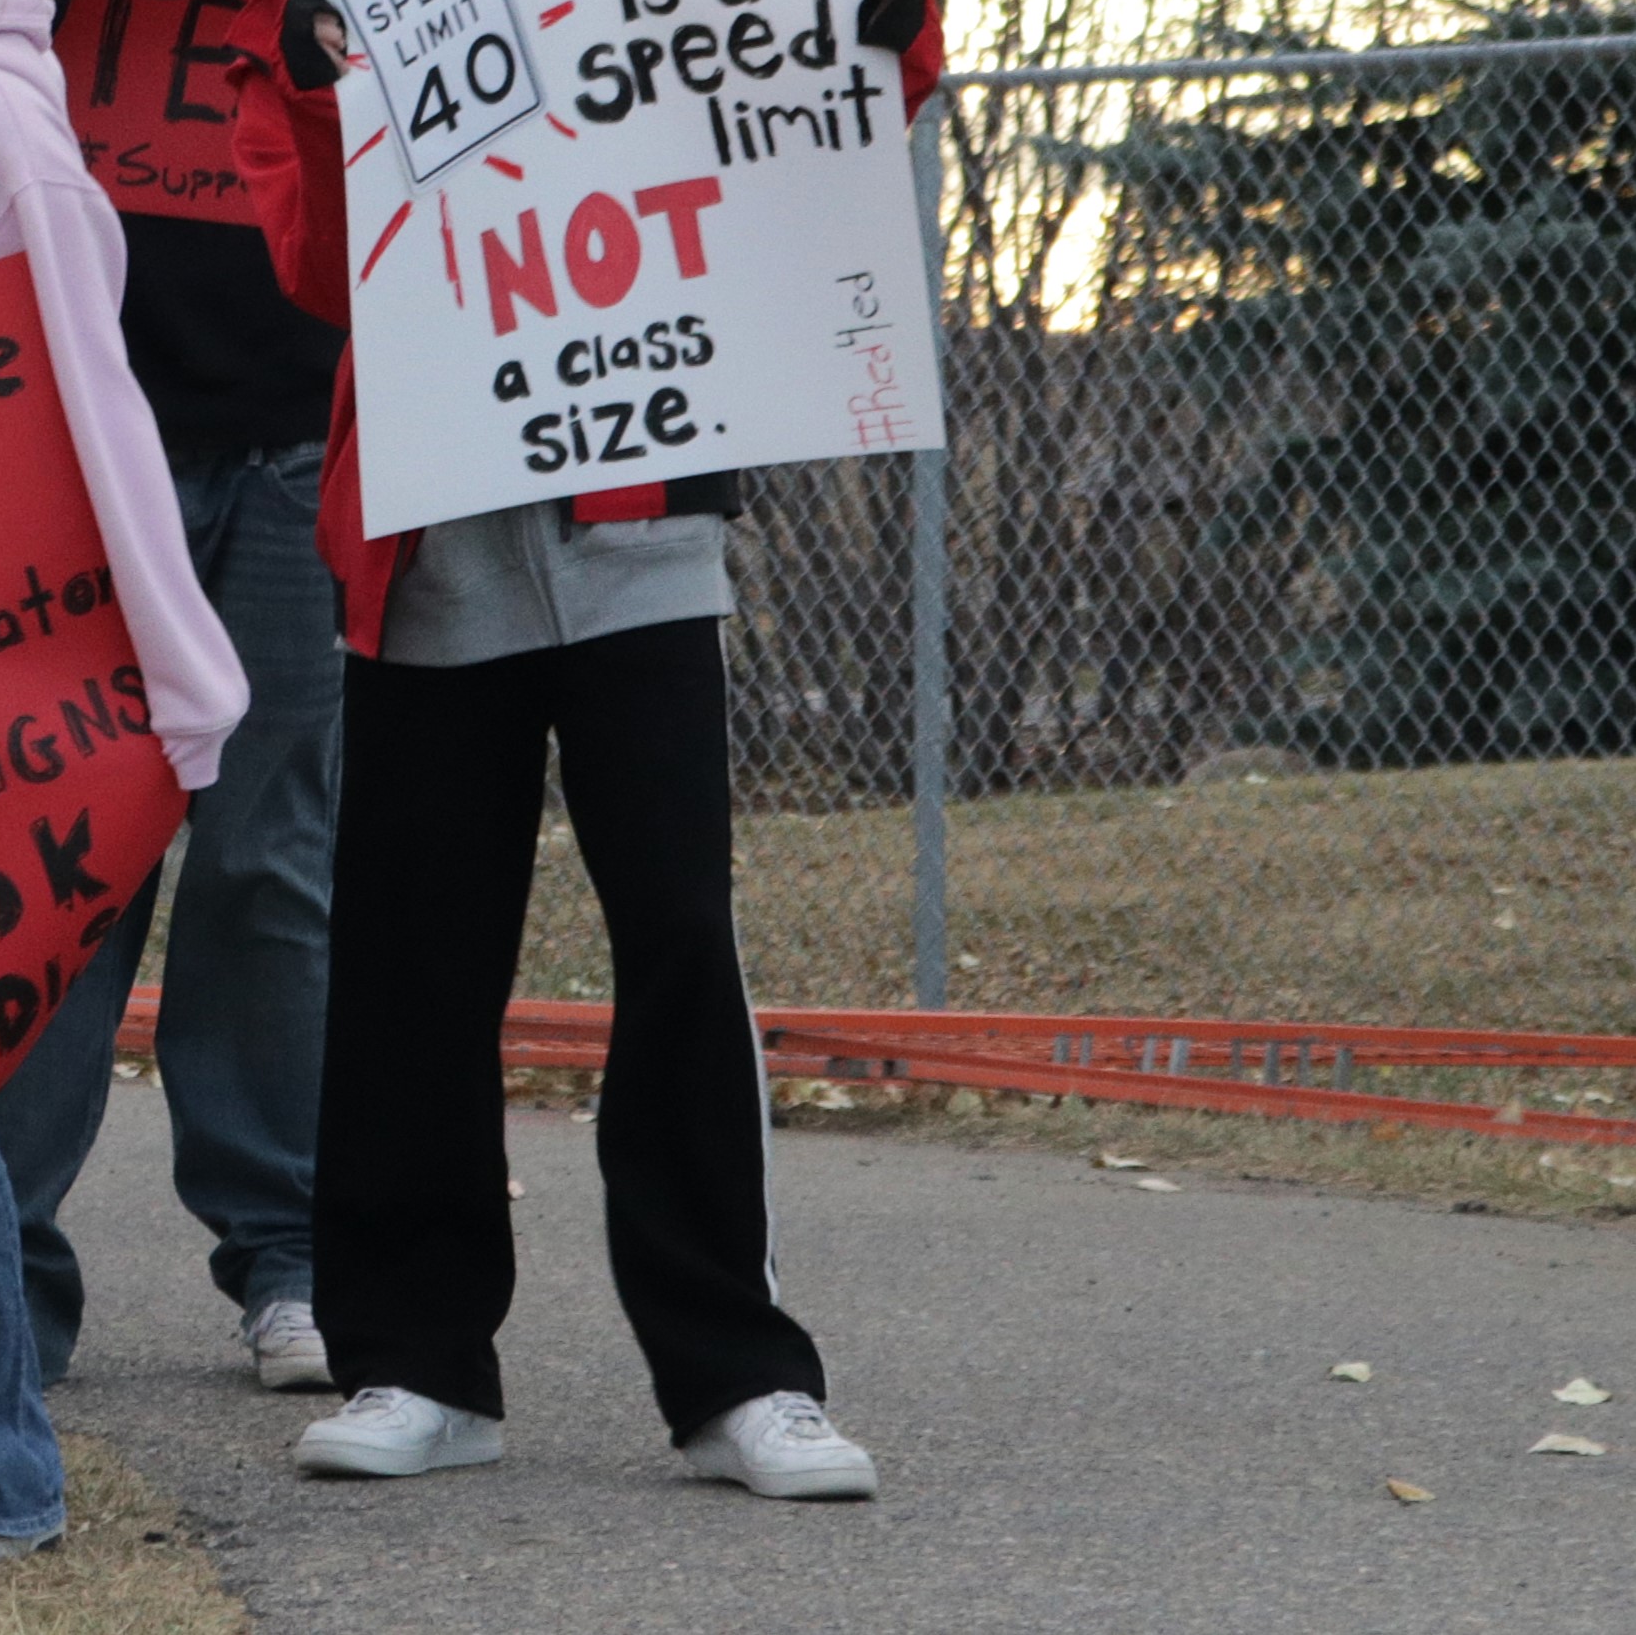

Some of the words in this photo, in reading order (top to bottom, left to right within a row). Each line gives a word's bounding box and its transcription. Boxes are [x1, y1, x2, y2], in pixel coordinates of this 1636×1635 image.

[408, 32, 516, 142] 40
[707, 64, 884, 167] limit
[480, 175, 724, 337] NOT
[493, 356, 531, 404] a
[555, 312, 716, 384] class
[520, 384, 727, 475] size.
